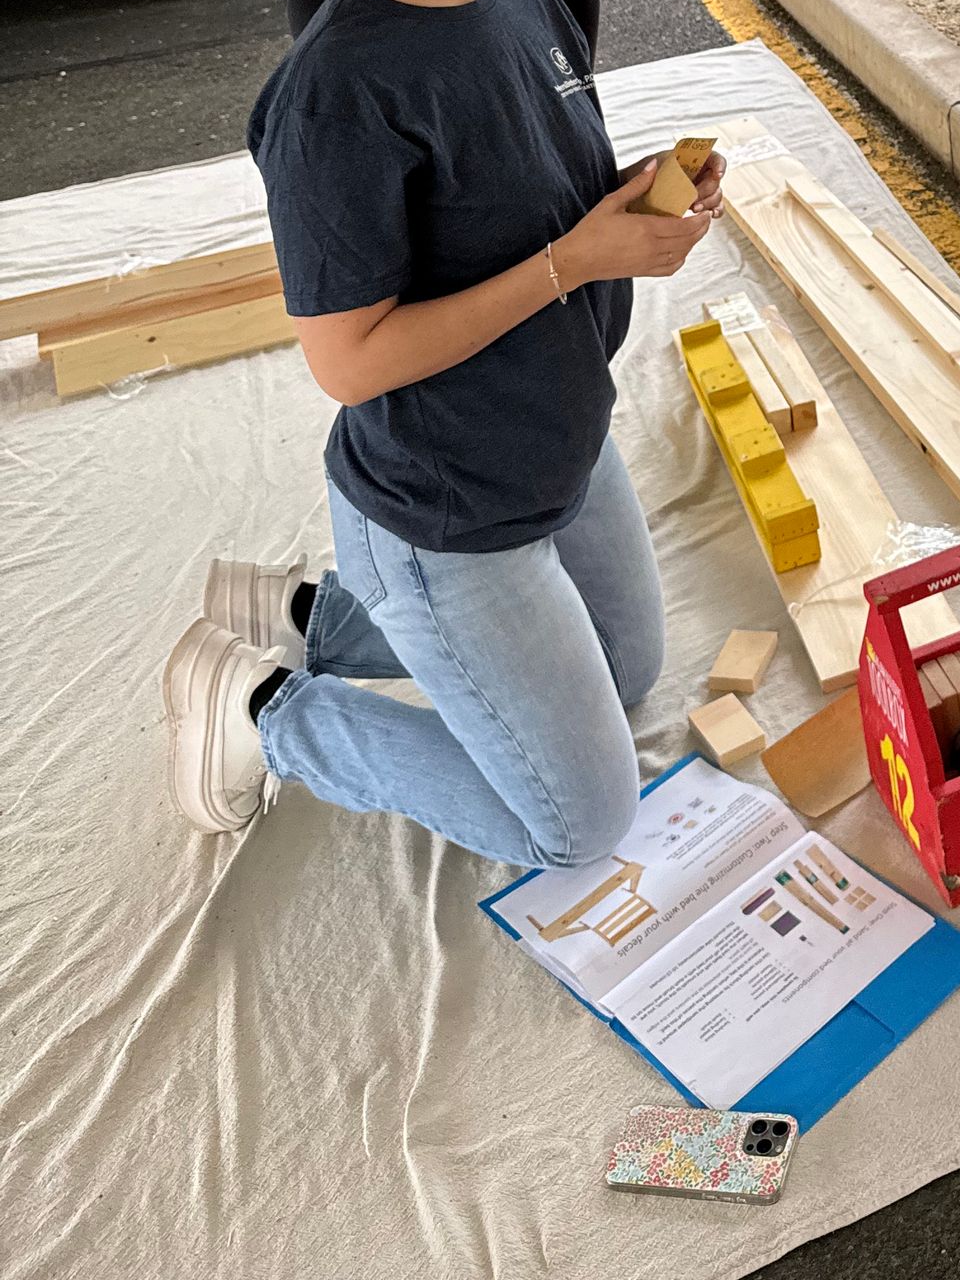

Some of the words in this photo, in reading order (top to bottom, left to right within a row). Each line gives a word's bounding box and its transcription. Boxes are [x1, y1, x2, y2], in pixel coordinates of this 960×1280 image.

[880, 732, 921, 852] 12
[768, 819, 788, 838] Step
[751, 833, 771, 852] Two:
[706, 846, 754, 887] Customizing
[694, 881, 710, 897] the
[679, 892, 697, 910] bed
[660, 904, 681, 924] with
[641, 917, 663, 938] your
[854, 925, 868, 940] Sand
[616, 933, 645, 959] decals
[832, 945, 845, 959] your
[820, 958, 832, 971] bed
[782, 968, 820, 1003] components
